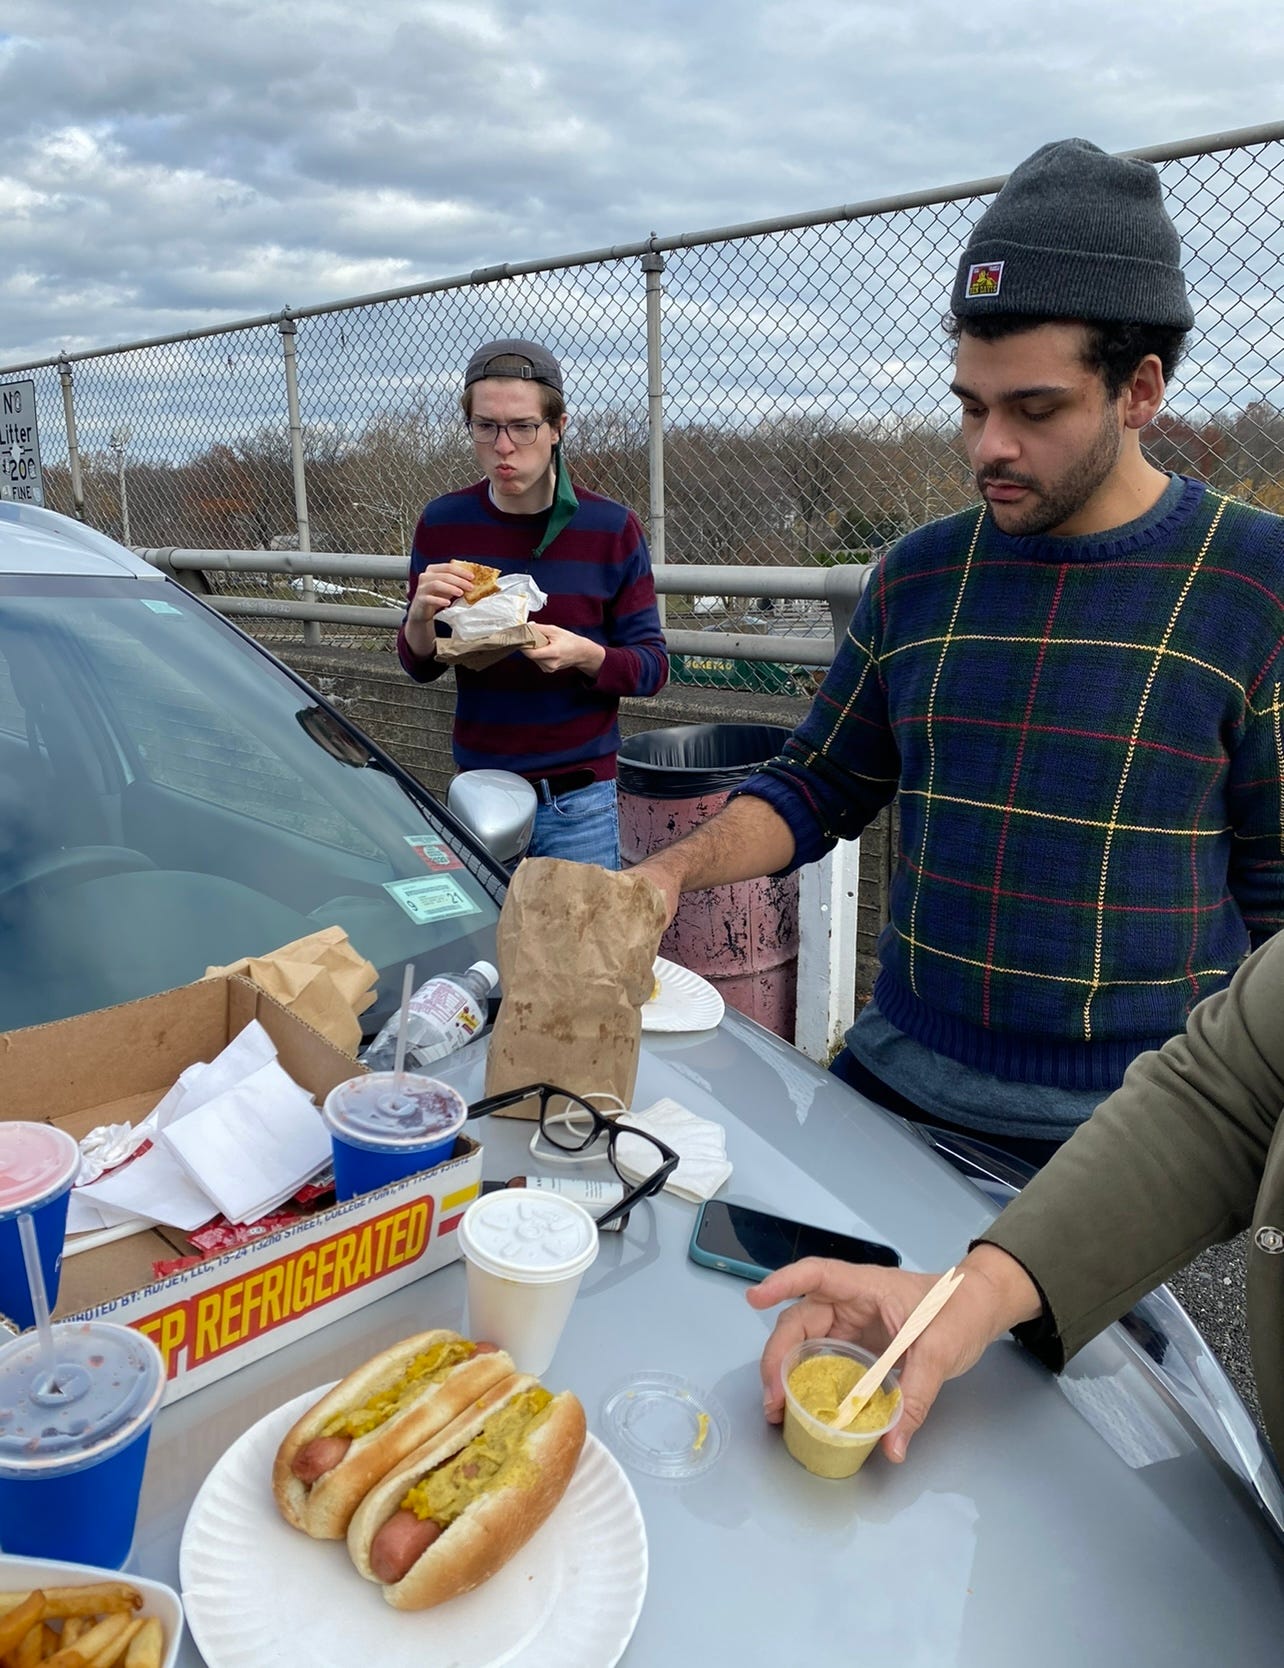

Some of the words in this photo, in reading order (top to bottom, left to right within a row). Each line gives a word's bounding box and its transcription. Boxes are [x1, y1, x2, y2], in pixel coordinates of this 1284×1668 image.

[3, 390, 22, 414] NO
[0, 424, 32, 445] Litter
[12, 486, 32, 500] FINE
[195, 1202, 429, 1361] REFRIGERATED
